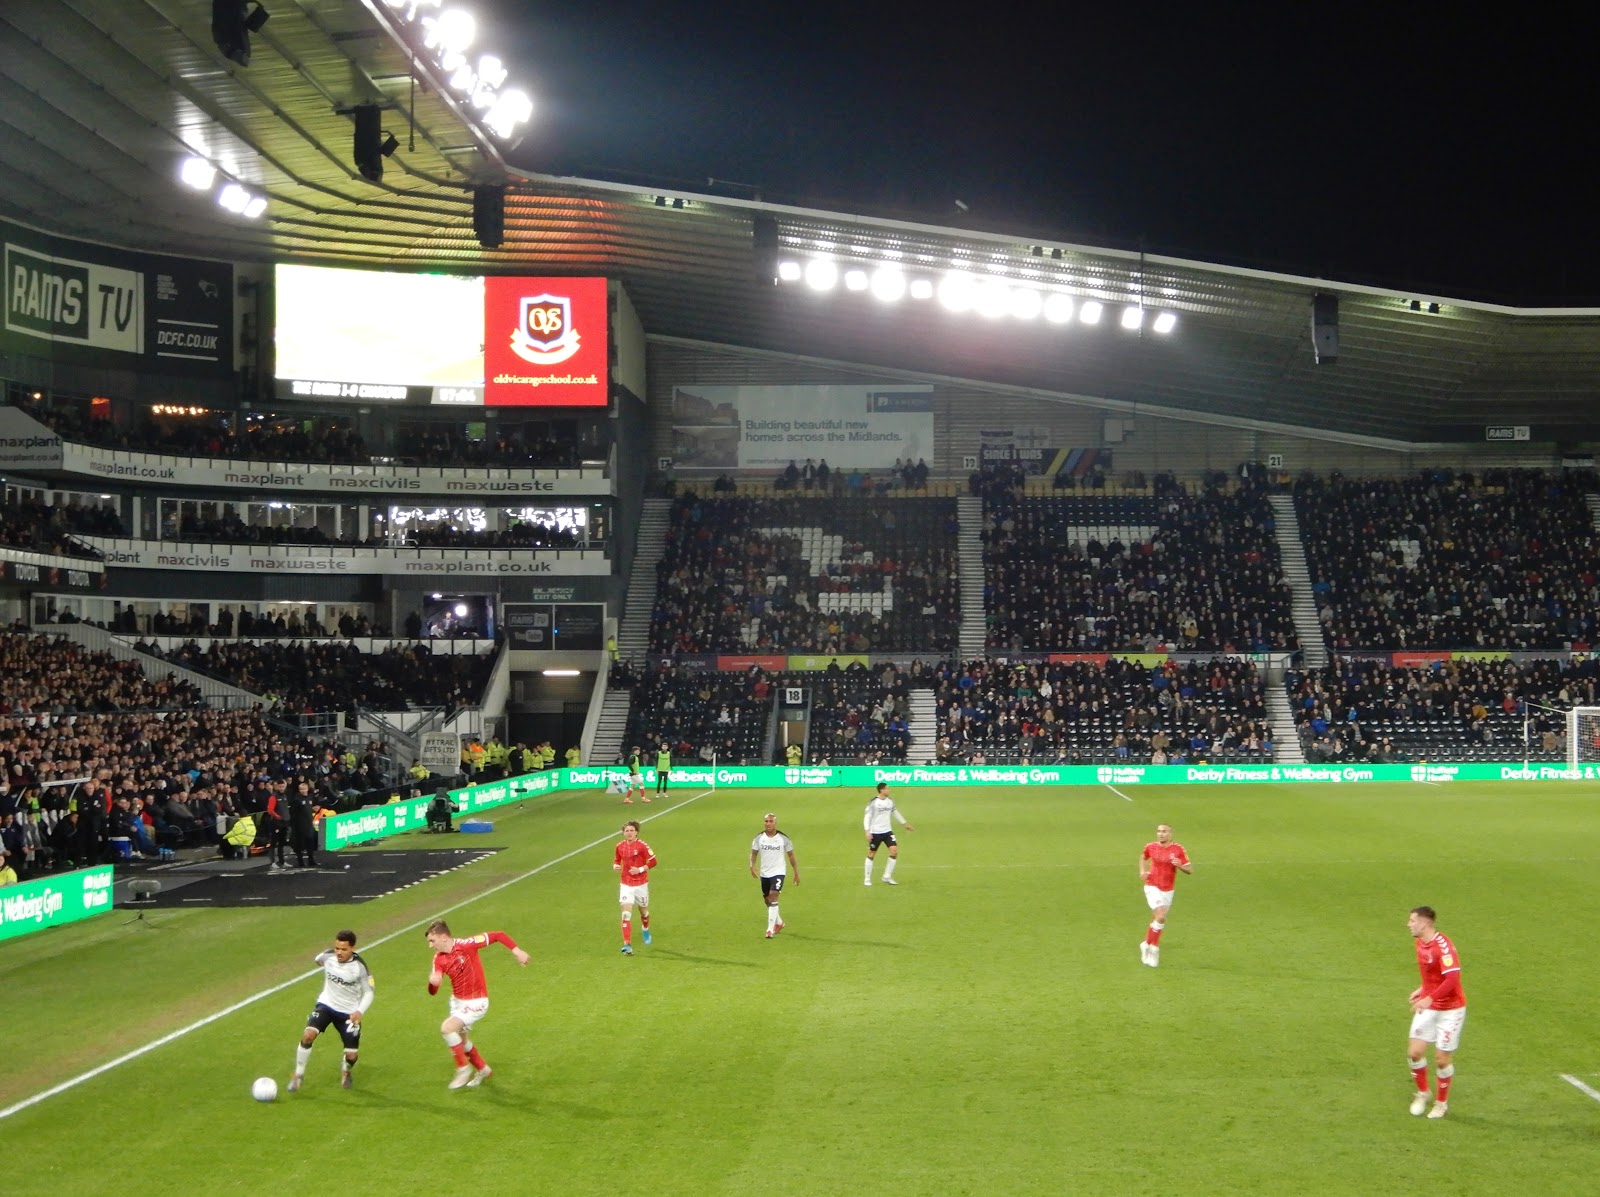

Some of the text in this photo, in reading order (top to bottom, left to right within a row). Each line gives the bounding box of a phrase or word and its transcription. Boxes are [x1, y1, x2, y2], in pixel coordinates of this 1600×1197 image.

[13, 265, 84, 325] RAMS
[99, 283, 135, 332] TV
[157, 331, 218, 350] DCFC.CO.UK
[493, 374, 598, 387] oldvicarageschool.co.uk
[745, 419, 868, 432] Building beautiful new
[745, 431, 902, 442] homes across the Midlands.
[1489, 429, 1513, 438] RAMS
[983, 450, 1010, 460] SINCE
[1019, 450, 1043, 460] WAS
[1270, 456, 1281, 467] 21
[964, 458, 976, 468] 19
[90, 461, 175, 479] maxplant.co.uk
[225, 472, 554, 491] maxplant maxcivils maxwaste
[157, 554, 230, 567] maxcivils
[251, 557, 347, 570] maxwaste
[405, 560, 551, 573] maxplant.co.uk
[511, 616, 533, 625] RAMS
[788, 691, 800, 701] 18
[569, 771, 600, 784] Derby
[646, 769, 656, 783] &
[717, 770, 747, 785] Gym
[801, 768, 832, 777] Nuffield
[874, 769, 1059, 784] Derby Fitness & Wellbeing Gym
[1114, 767, 1145, 776] Nuffield
[1187, 768, 1373, 782] Derby Fitness & Wellbeing Gym
[1427, 766, 1459, 775] Nuffield
[1501, 766, 1595, 781] Derby Fitness &
[801, 776, 827, 784] Health
[1114, 774, 1140, 783] Health
[1427, 774, 1453, 782] Health
[4, 888, 62, 922] Wellbeing Gym
[327, 972, 356, 987] 32Red
[1444, 1031, 1451, 1044] 3
